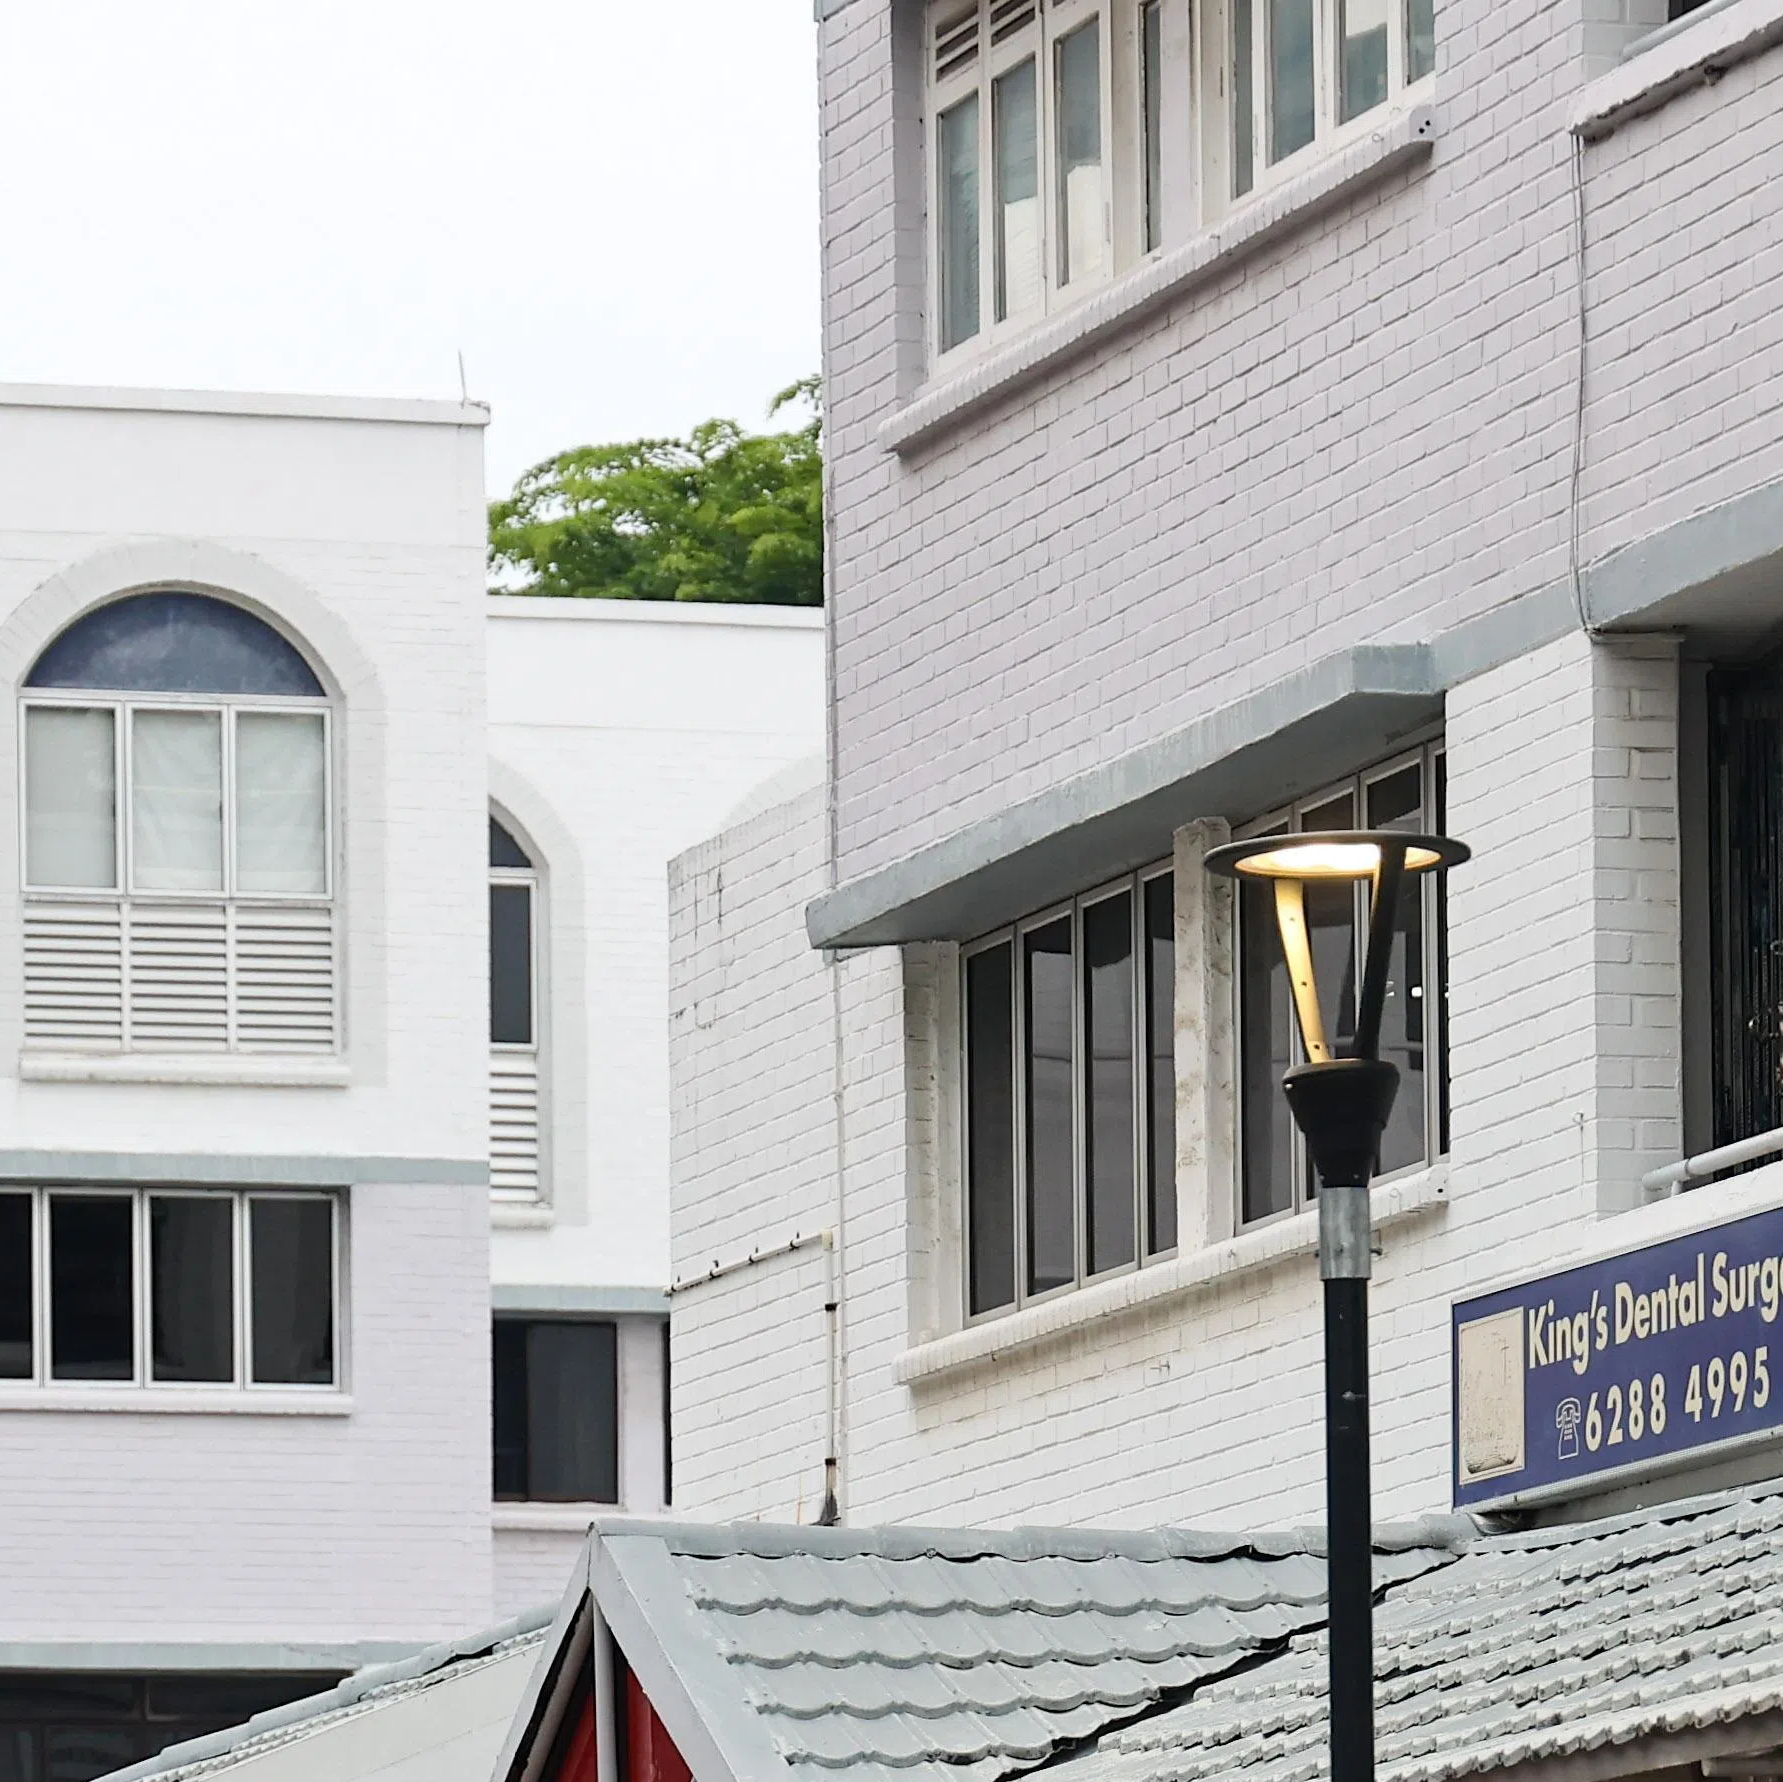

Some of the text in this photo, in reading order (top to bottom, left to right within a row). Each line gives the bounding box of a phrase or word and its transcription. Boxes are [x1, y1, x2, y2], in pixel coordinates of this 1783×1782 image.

[1528, 1289, 1607, 1376] King's
[1614, 1252, 1705, 1345] Dental
[1584, 1345, 1770, 1452] 6288 4995
